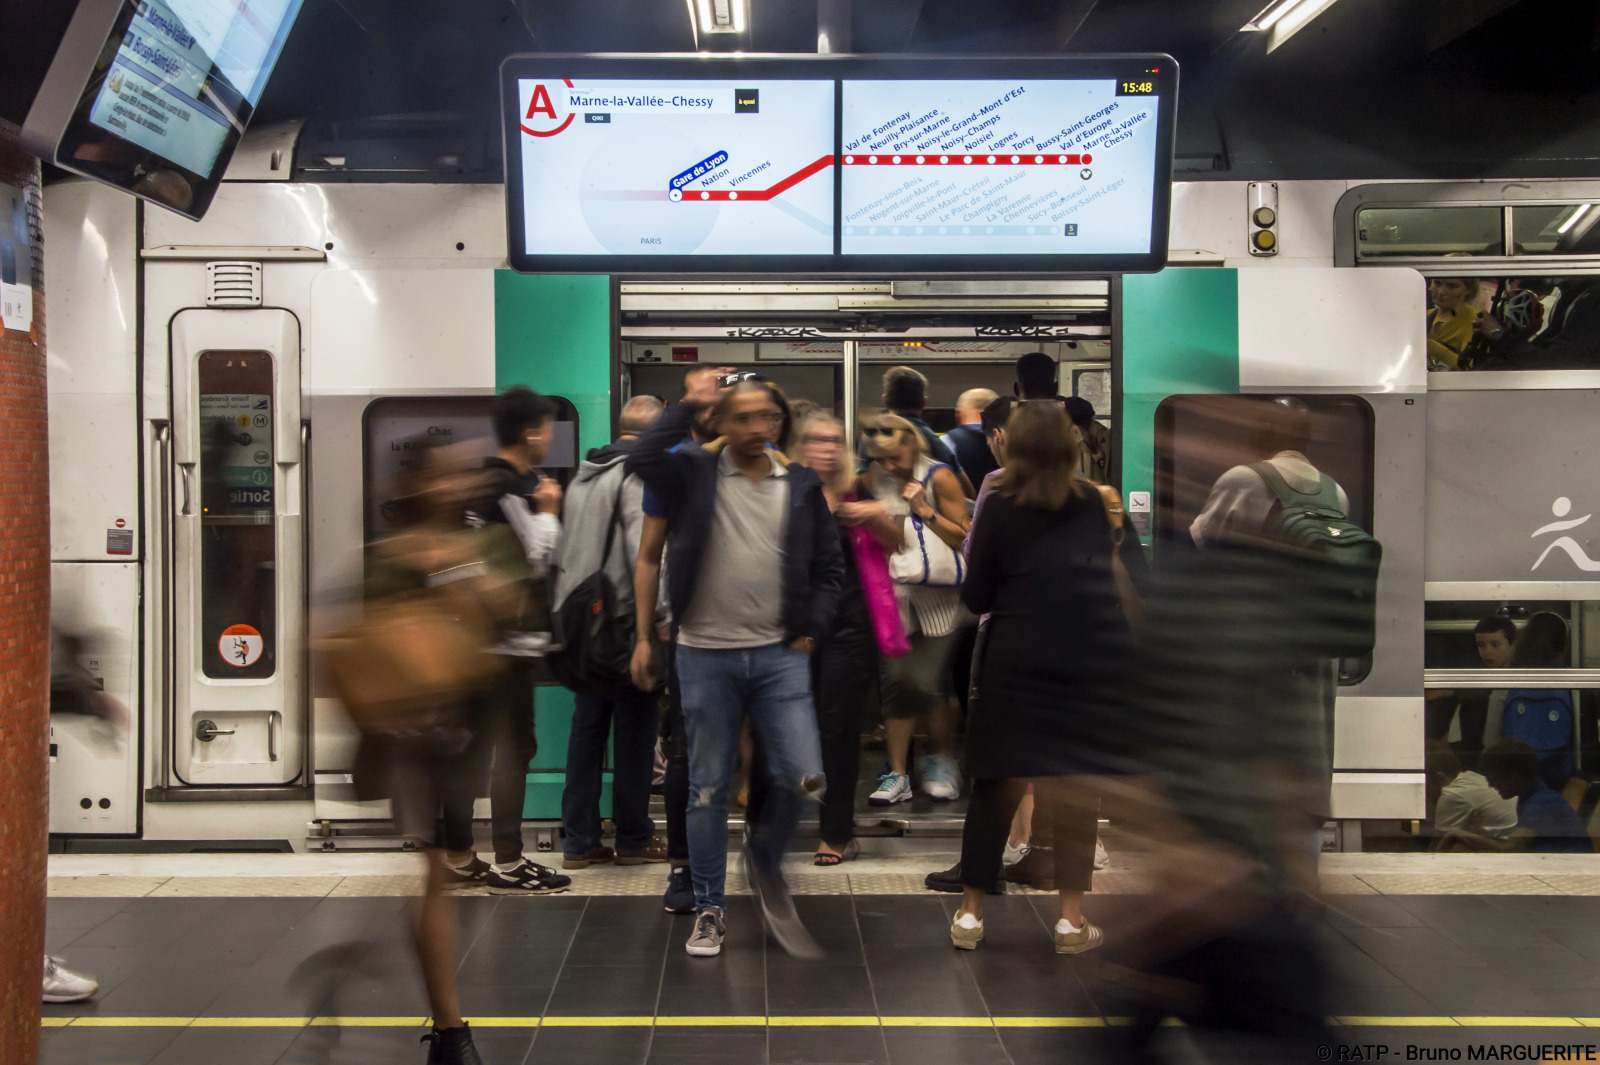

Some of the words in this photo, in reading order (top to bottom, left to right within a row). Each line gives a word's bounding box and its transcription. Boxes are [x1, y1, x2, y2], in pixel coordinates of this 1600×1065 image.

[526, 84, 558, 119] A
[1004, 86, 1026, 102] d'Est
[1122, 82, 1152, 92] 15:48
[846, 139, 860, 151] Val
[861, 133, 872, 143] de
[872, 111, 911, 136] Fontenay
[870, 109, 938, 152] Neuilly-Plaisance
[893, 116, 950, 152] Bry-sur-Marne
[964, 130, 994, 151] Noisiel
[988, 131, 1018, 152] Lognes
[1036, 101, 1119, 151] Bussy-Saint-Georges
[1060, 140, 1074, 151] Val
[1075, 118, 1113, 143] d'Europe
[1082, 111, 1148, 151] Marne-la-Vallée
[1104, 129, 1133, 149] Chessy
[1012, 135, 1035, 151] Torcy
[673, 173, 693, 187] Gare
[693, 166, 705, 176] de
[704, 154, 726, 169] Lyon
[701, 168, 730, 187] Nation
[729, 161, 771, 187] Vincennes
[845, 176, 923, 222] Fontenay-sous-Bois
[869, 179, 940, 222] Nogent-sur-Marne
[939, 213, 950, 223] Le
[950, 203, 969, 216] Parc
[970, 196, 981, 206] de
[982, 169, 1027, 198] Saint-Maur
[963, 194, 1008, 222] Champigny
[986, 213, 997, 223] La
[997, 194, 1032, 215] Varenne
[1004, 188, 1058, 223] Chennevières
[1051, 177, 1126, 222] Boissy-Saint-Léger
